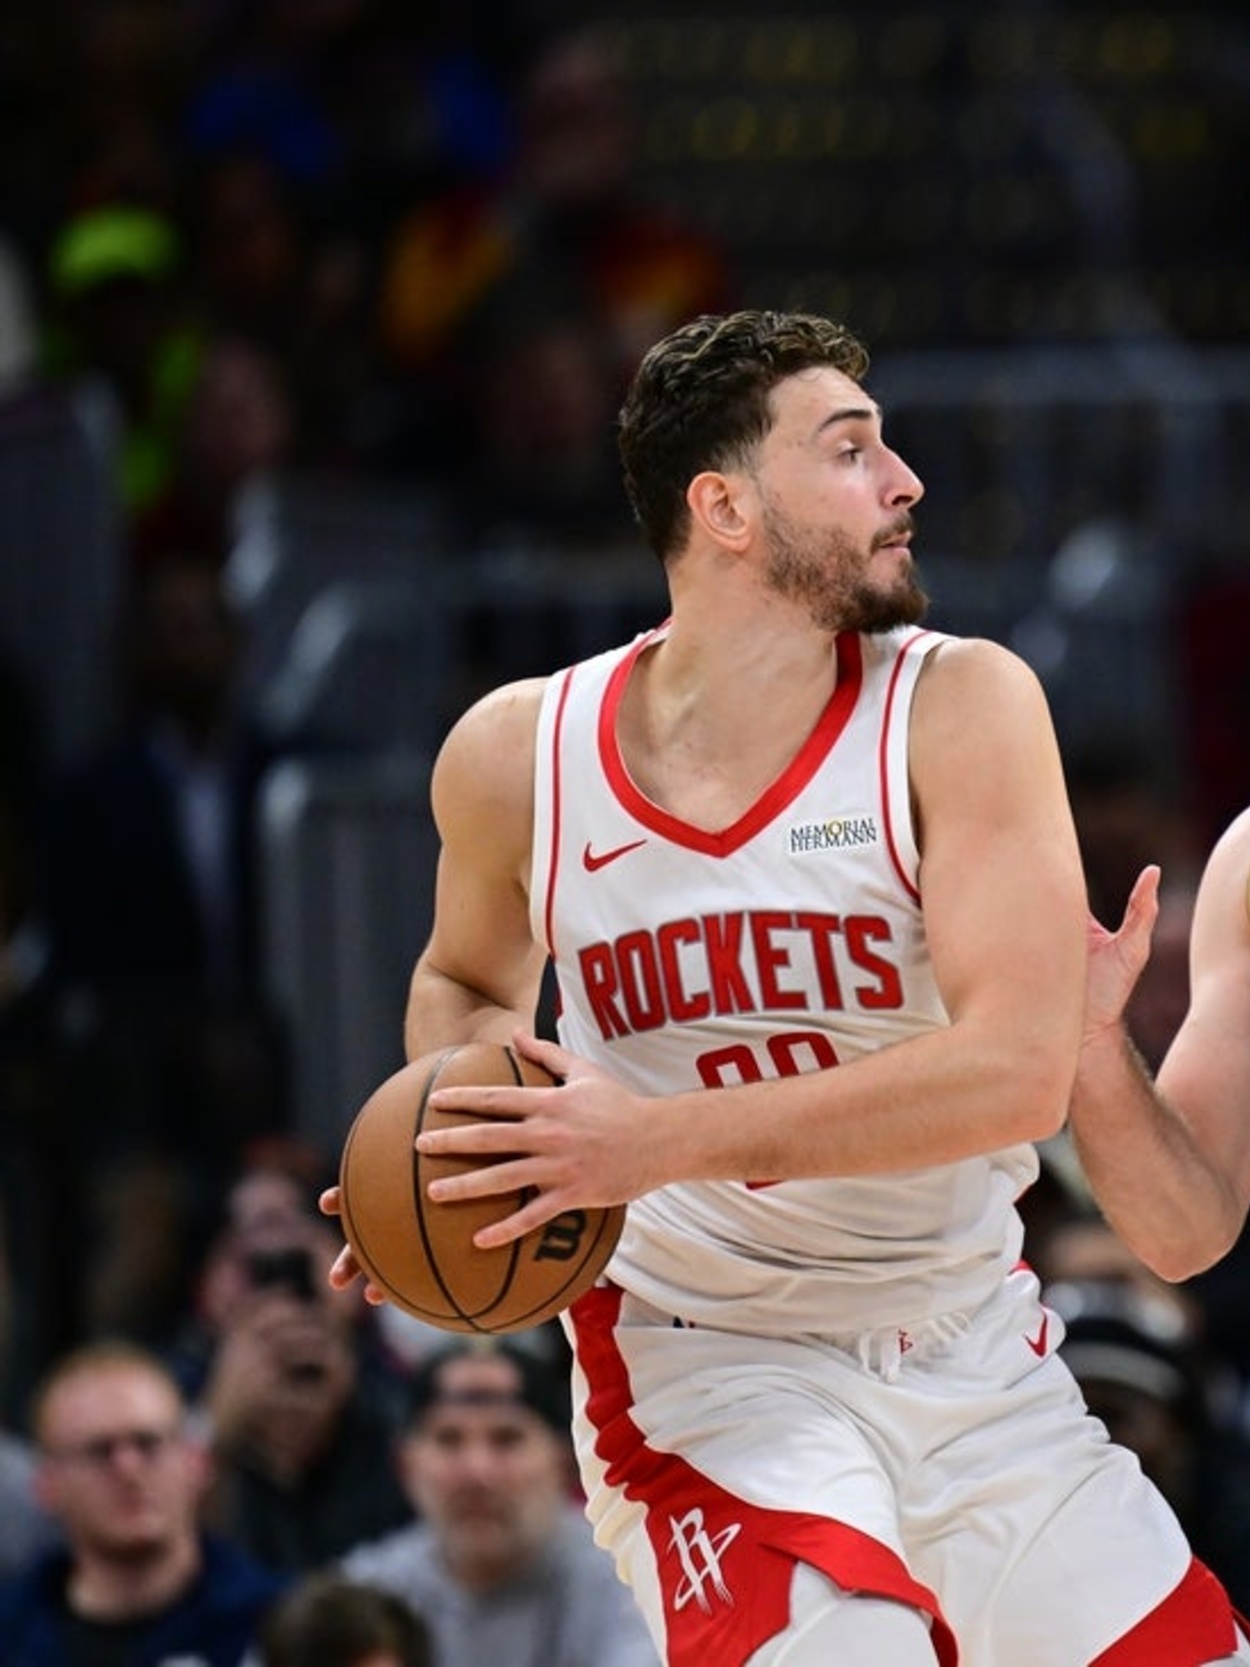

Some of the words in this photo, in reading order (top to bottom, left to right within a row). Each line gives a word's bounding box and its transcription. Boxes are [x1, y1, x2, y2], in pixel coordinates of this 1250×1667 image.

[791, 818, 874, 840] MEMORIAL
[791, 827, 877, 853] HERMANN
[578, 910, 904, 1042] ROCKETS
